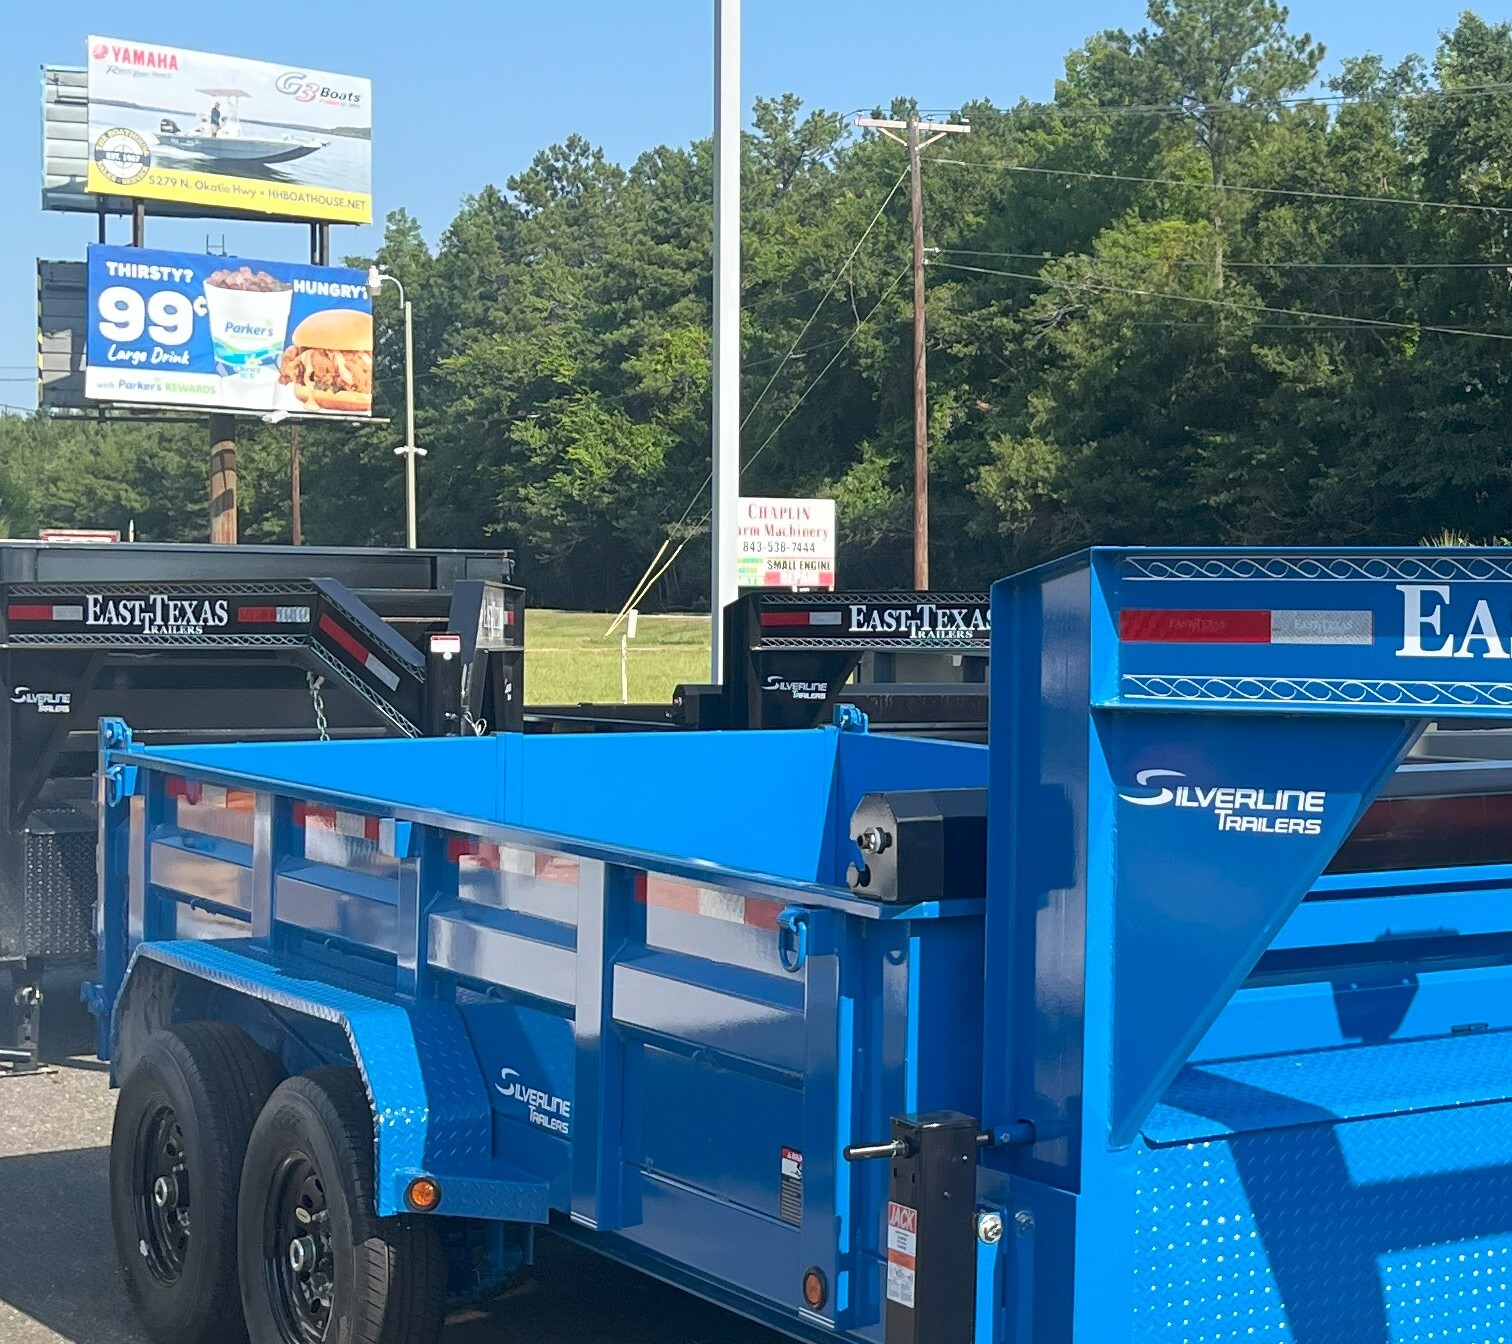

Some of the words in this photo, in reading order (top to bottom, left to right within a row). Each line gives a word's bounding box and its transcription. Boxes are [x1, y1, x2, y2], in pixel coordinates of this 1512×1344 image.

[112, 45, 178, 71] YAMAHA
[275, 71, 320, 102] G3
[320, 86, 361, 103] Boats
[148, 175, 177, 187] 5279
[180, 178, 192, 189] N.
[233, 184, 257, 199] Hwy
[268, 189, 366, 210] HHBOATHOUSE.NET
[105, 261, 194, 284] THIRSTY?
[107, 343, 148, 365] Large
[150, 346, 190, 365] Drink
[165, 382, 217, 394] REWARDS
[748, 503, 811, 520] CHAPLIN
[764, 523, 829, 542] Machinery
[743, 541, 815, 553] 843-538-7444
[767, 559, 796, 570] SMALL
[799, 560, 831, 570] ENGINE
[85, 594, 145, 625] EAST
[149, 594, 228, 626] TEXAS
[848, 604, 911, 631] EAST
[141, 612, 203, 635] TRAILERS
[907, 619, 973, 639] TRAILERS
[10, 686, 71, 704] SILVERLINE
[761, 675, 828, 692] SILVERLINE
[792, 689, 826, 700] TRAILERS
[1118, 768, 1326, 813] SILVERLINE
[1214, 809, 1322, 835] TRAILERS
[494, 1067, 571, 1118] SILVERLINE
[528, 1105, 569, 1135] TRAILERS
[889, 1205, 914, 1232] JACK
